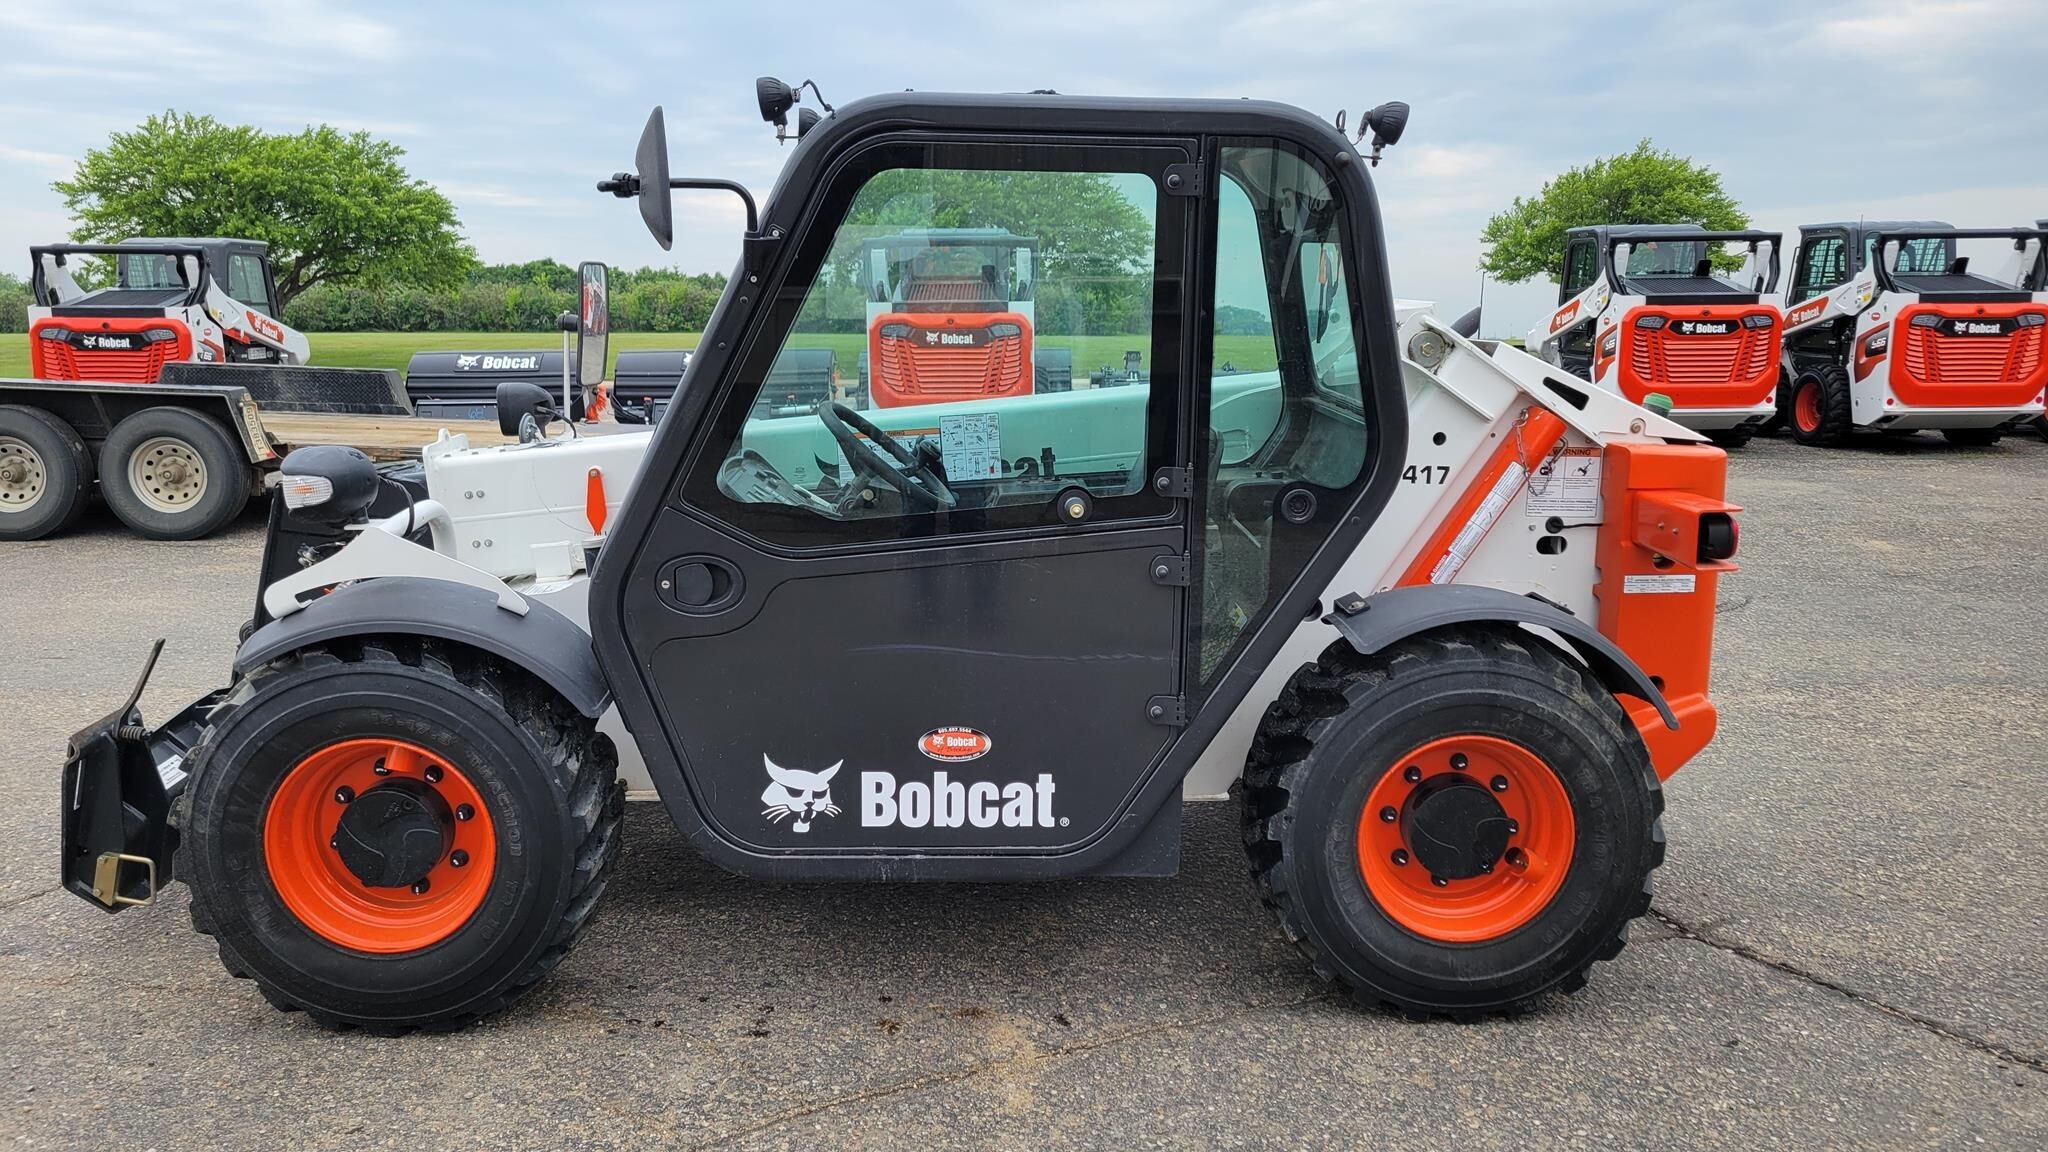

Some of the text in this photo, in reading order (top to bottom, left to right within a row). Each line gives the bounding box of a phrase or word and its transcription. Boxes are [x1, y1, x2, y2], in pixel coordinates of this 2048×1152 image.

[1800, 306, 1820, 322] Bobcat
[1696, 324, 1728, 334] Bobcat
[1969, 323, 2001, 334] Bobcat
[98, 337, 131, 348] Bobcat
[941, 333, 974, 344] Bobcat
[482, 355, 537, 369] Bobcat
[1402, 464, 1451, 484] 417
[947, 736, 977, 747] Bobcat
[861, 771, 1056, 828] Bobcat
